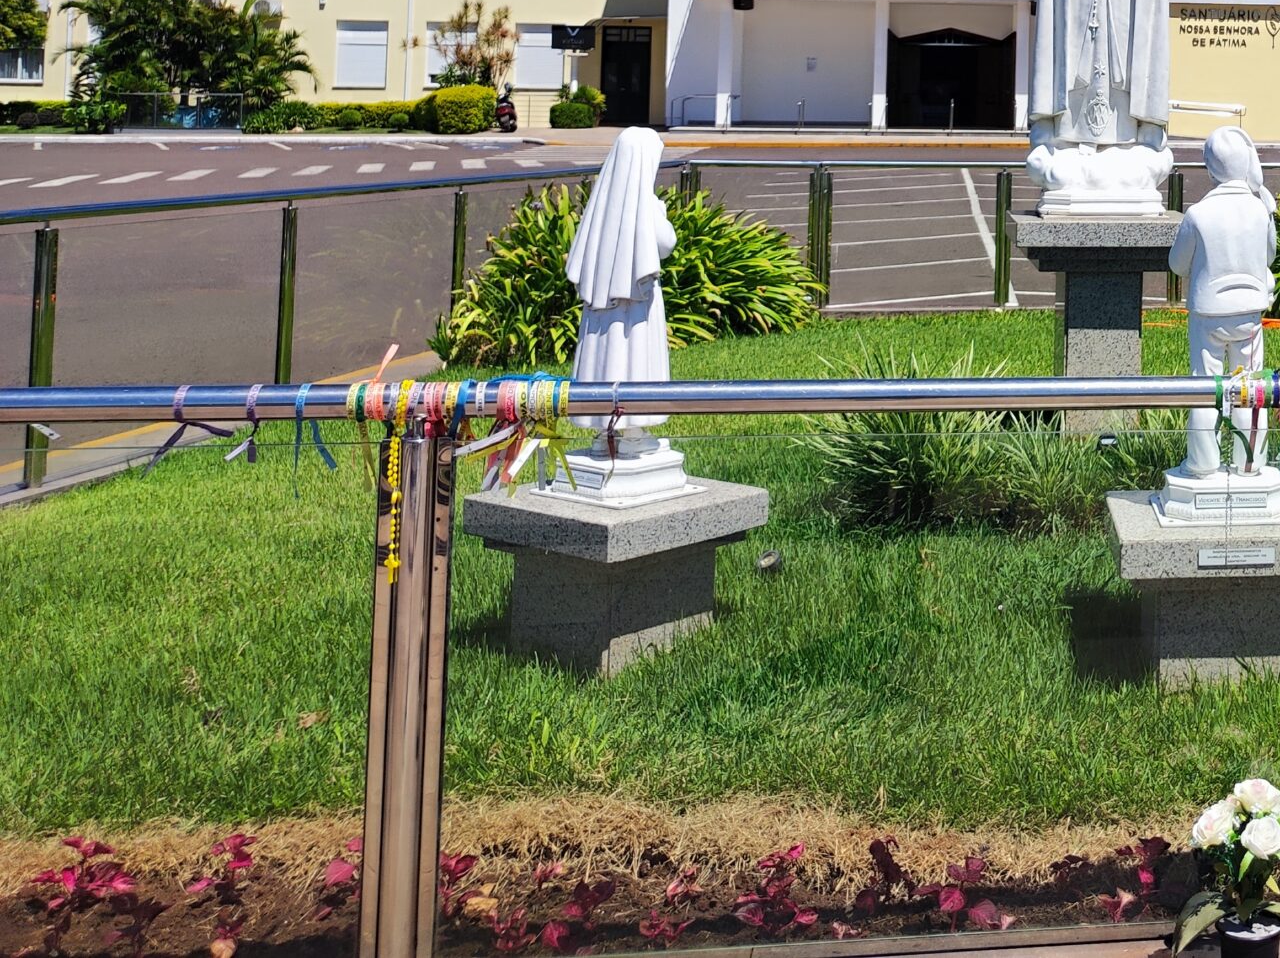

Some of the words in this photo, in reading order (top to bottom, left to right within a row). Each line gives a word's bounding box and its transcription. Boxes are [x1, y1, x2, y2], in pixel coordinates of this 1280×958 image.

[1180, 6, 1260, 22] SANTUÁRIO
[1179, 25, 1210, 34] NOSSA
[1213, 26, 1260, 36] SENHORA
[1192, 38, 1206, 47] DE
